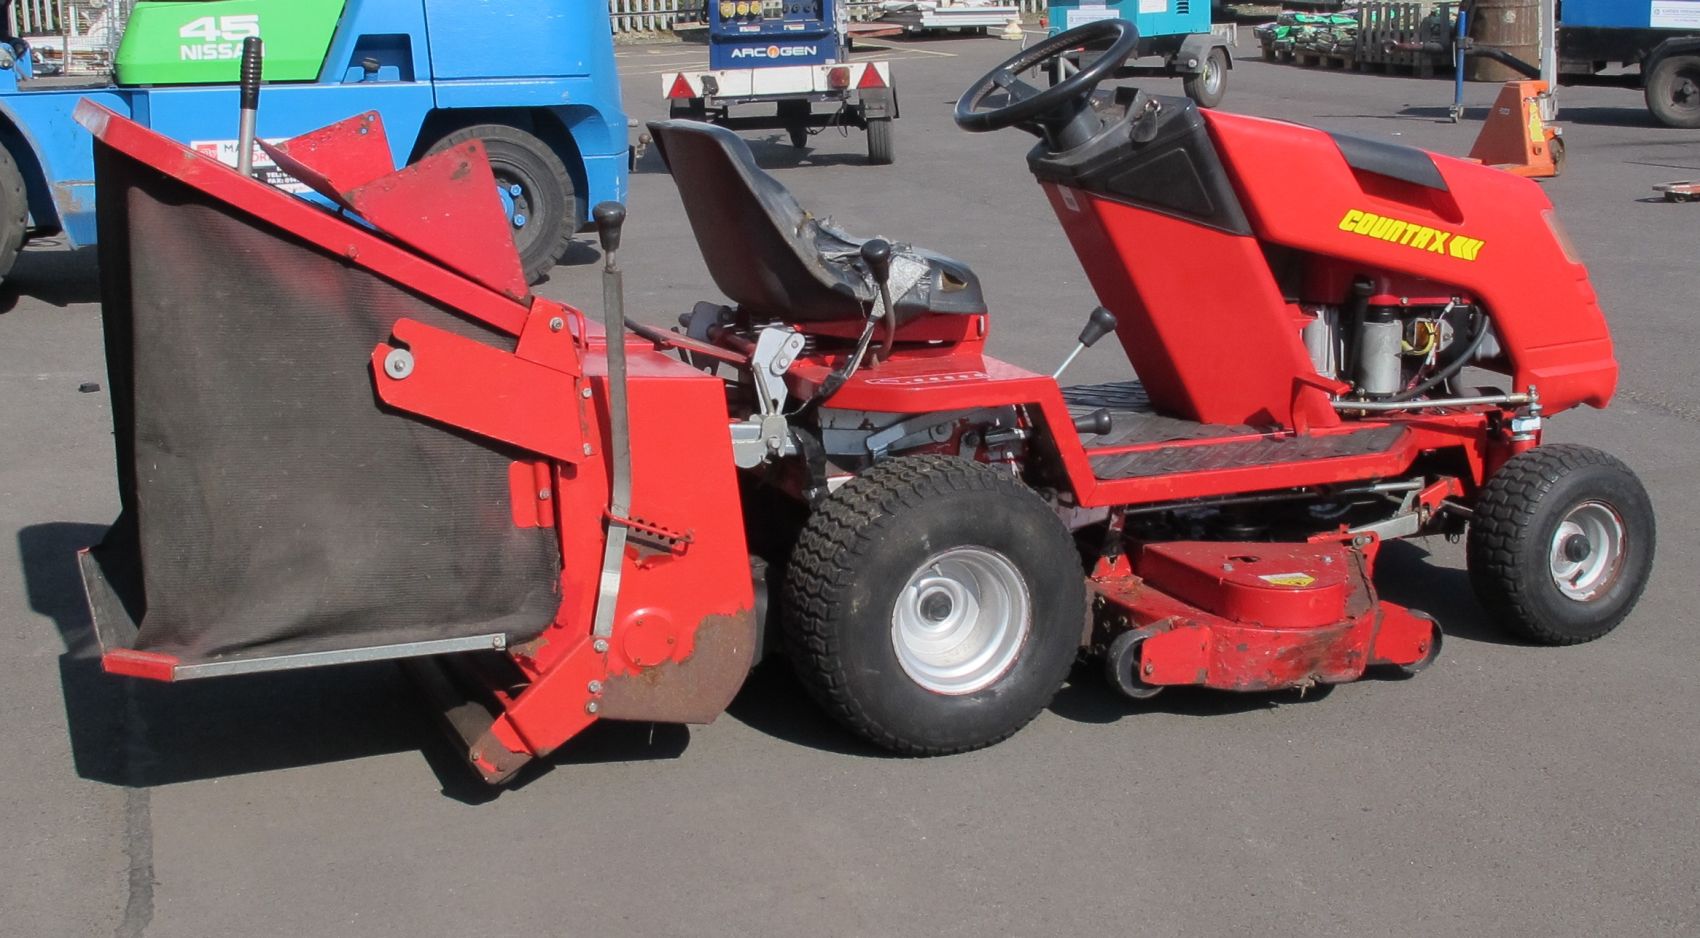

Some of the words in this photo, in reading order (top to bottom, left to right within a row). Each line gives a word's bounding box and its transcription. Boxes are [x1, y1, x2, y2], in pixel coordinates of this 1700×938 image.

[179, 14, 260, 41] 45
[180, 42, 265, 60] NISSA
[1338, 208, 1451, 255] COUNTAX
